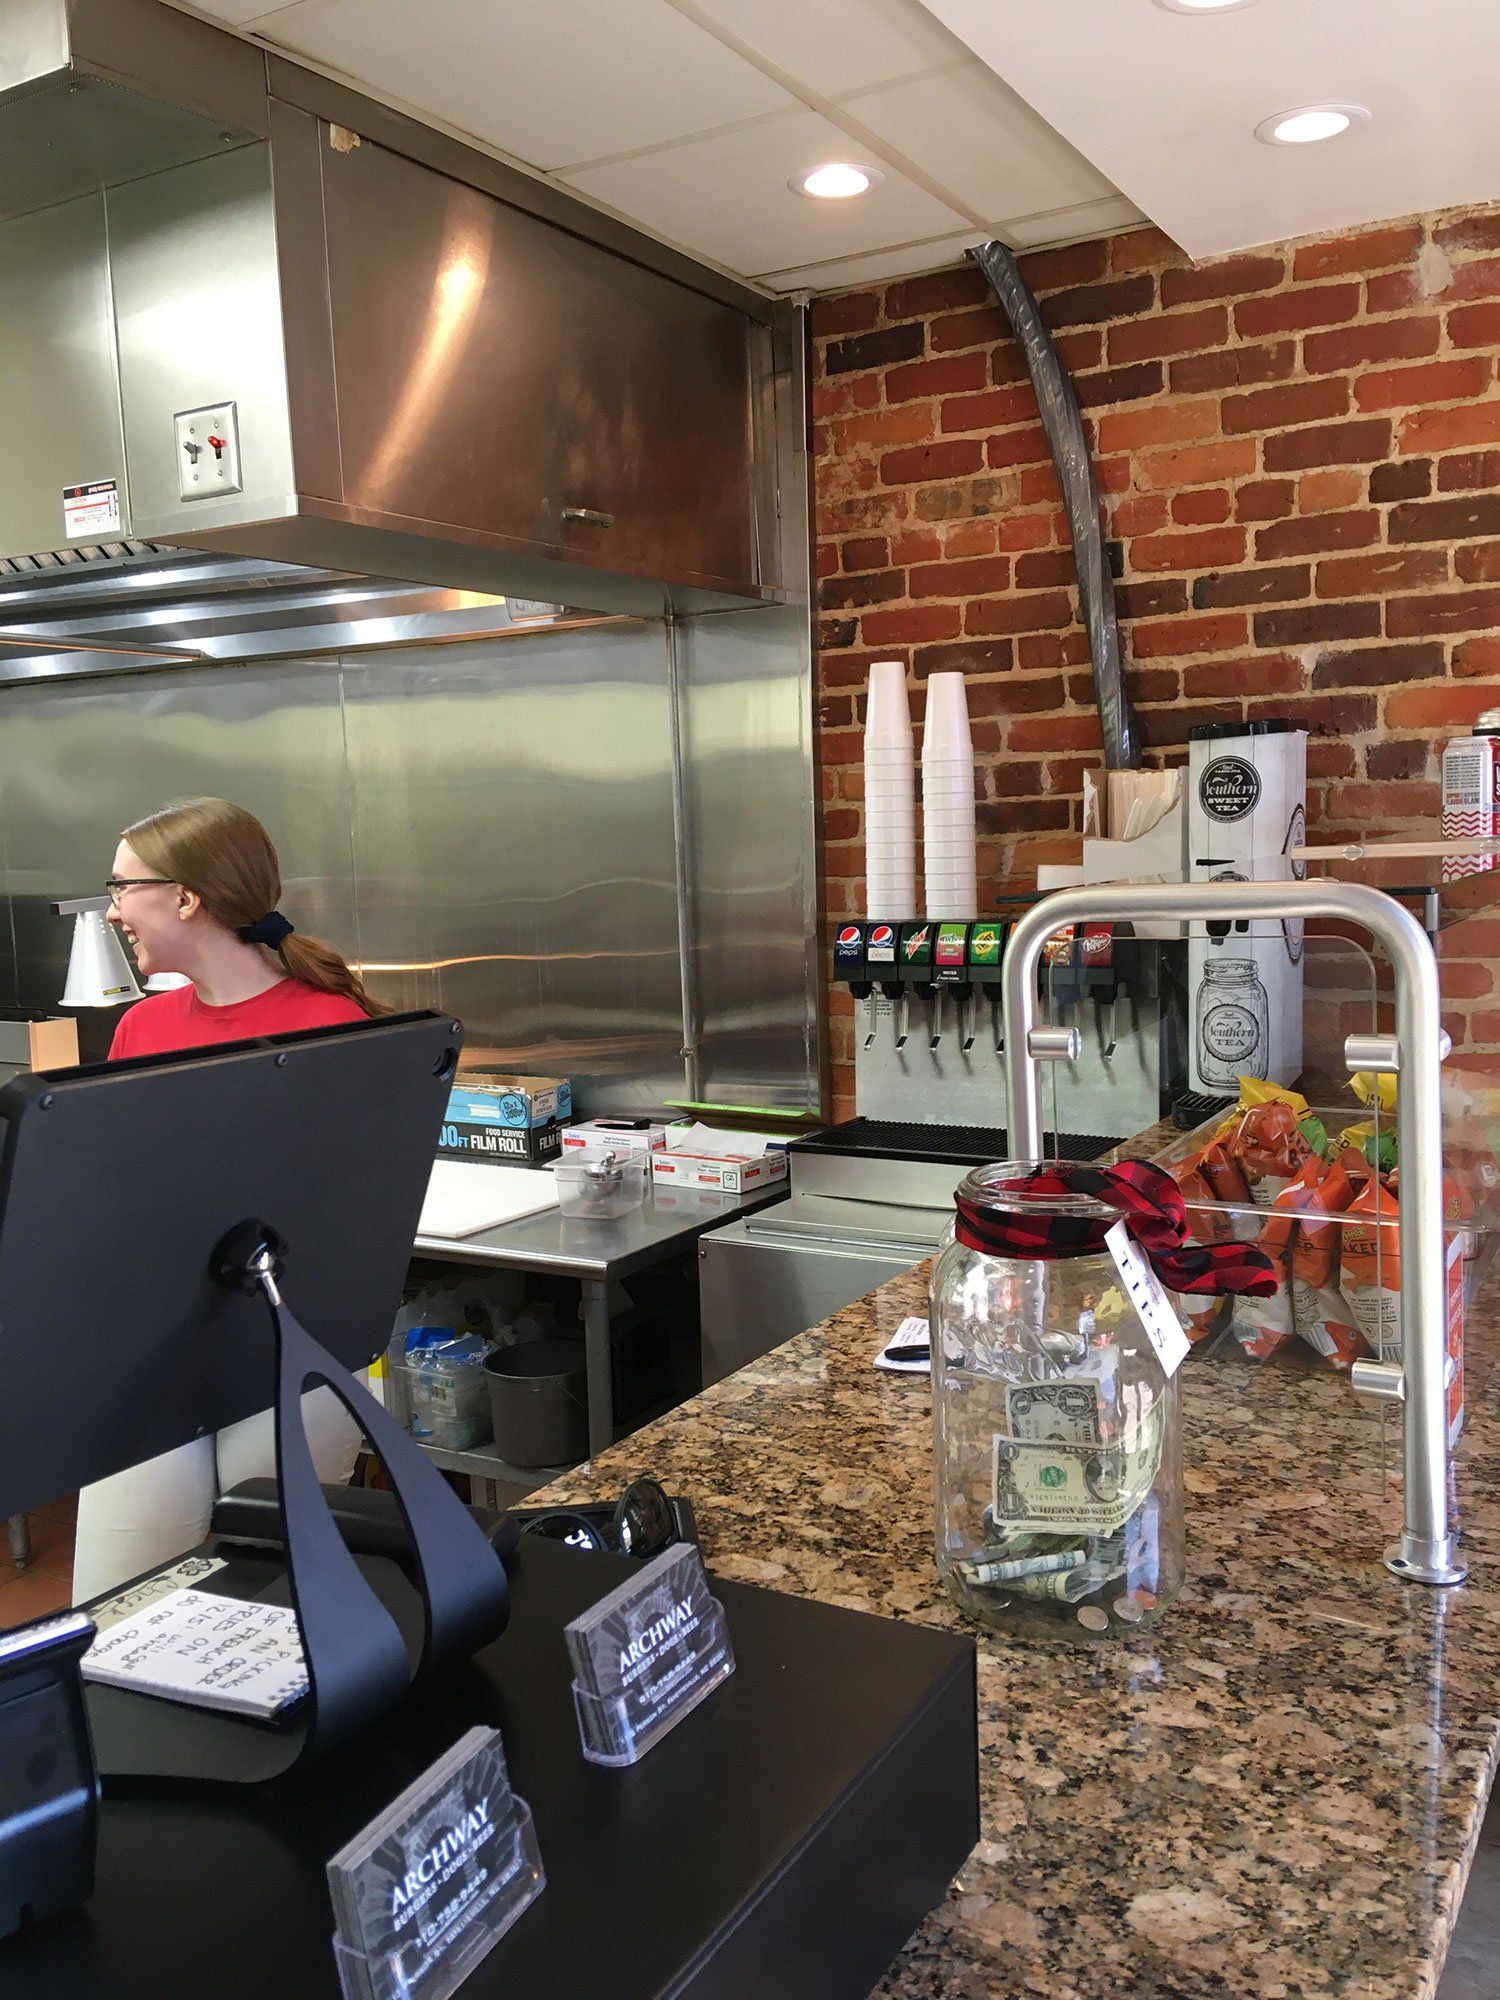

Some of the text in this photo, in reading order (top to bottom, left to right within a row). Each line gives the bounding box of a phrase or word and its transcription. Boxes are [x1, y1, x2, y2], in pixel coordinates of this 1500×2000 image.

[1205, 774, 1258, 796] Southern
[838, 948, 859, 957] pepsi
[1210, 1021, 1255, 1038] Southern
[1215, 1039, 1246, 1047] TEA
[485, 1127, 526, 1139] FOOD SERVICE
[470, 1134, 497, 1151] FILM
[498, 1137, 527, 1154] ROLL
[146, 1610, 174, 1627] not
[175, 1604, 265, 1657] FRIES ON
[194, 1610, 287, 1666] OF FRENCH
[618, 1594, 695, 1675] ARCHWAY
[249, 1638, 279, 1655] AN
[621, 1653, 656, 1687] BURGERS
[659, 1633, 680, 1657] DOGS
[682, 1616, 700, 1639] BEER
[391, 1796, 490, 1916] ARCHWAY
[393, 1883, 439, 1932] BURGERS
[441, 1854, 468, 1884] DOGS
[471, 1823, 497, 1852] BEER
